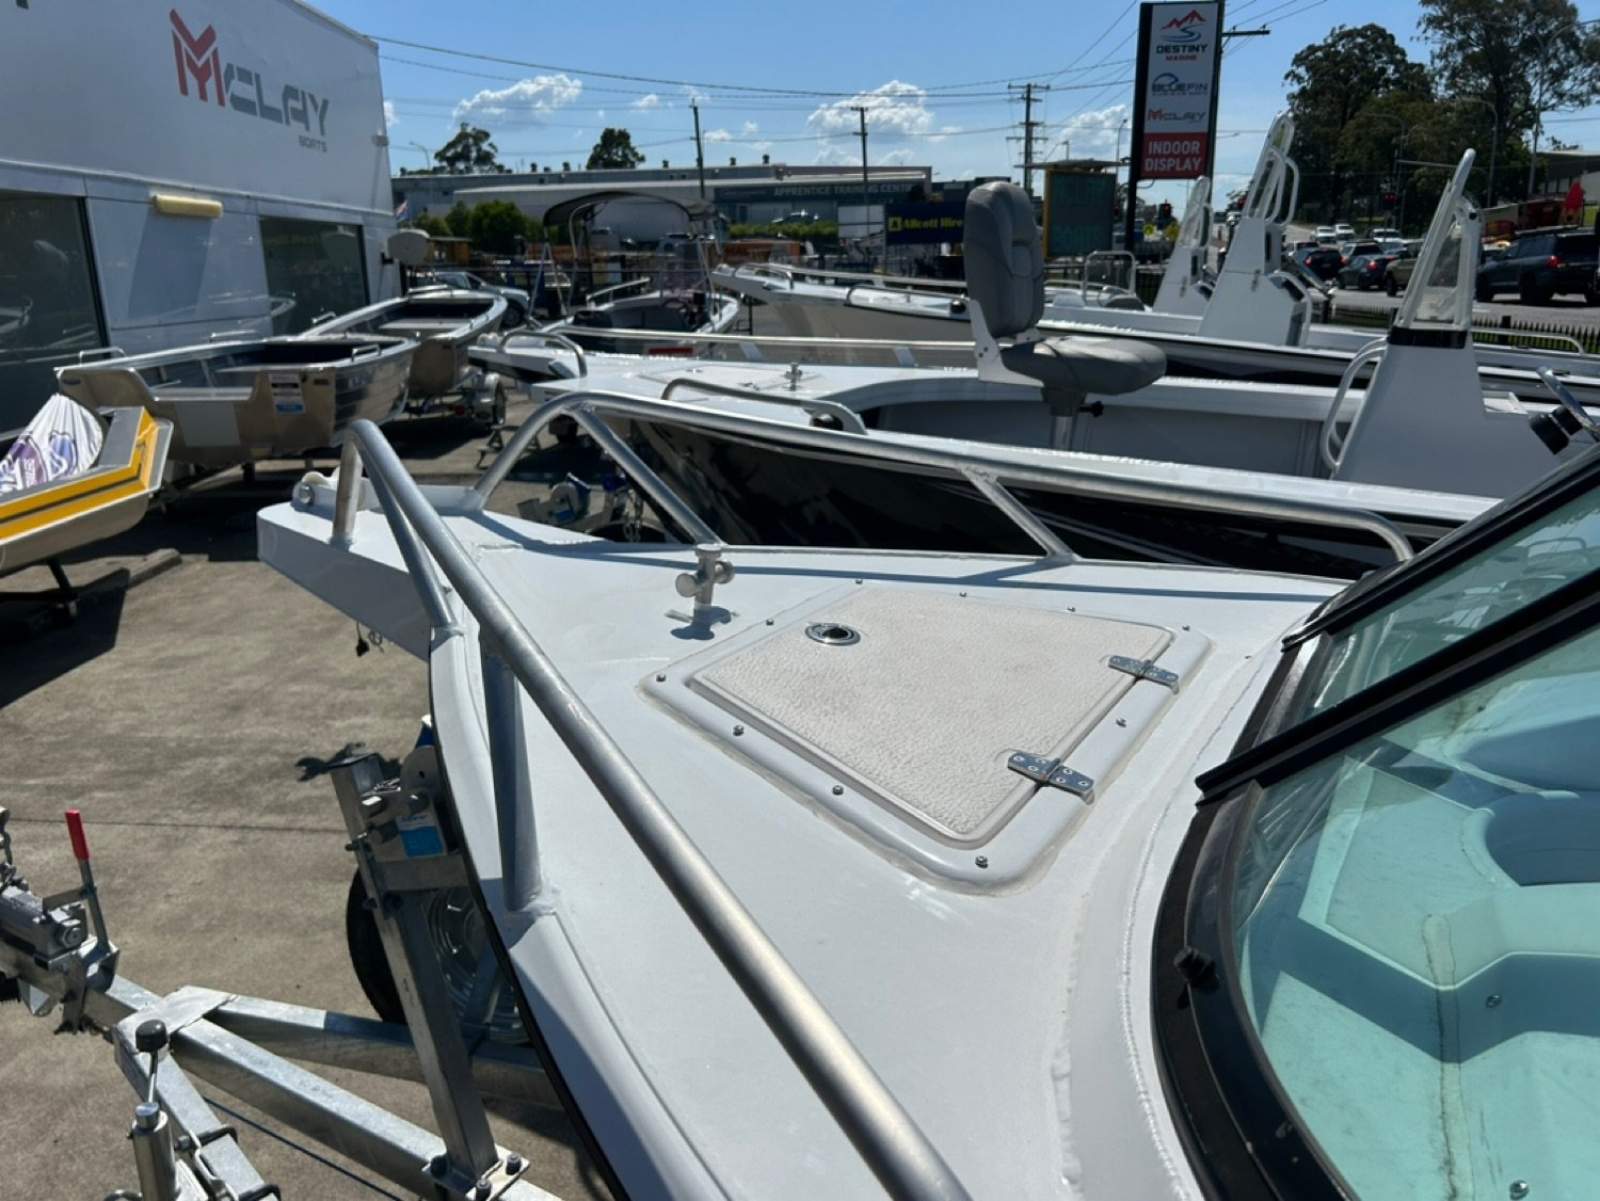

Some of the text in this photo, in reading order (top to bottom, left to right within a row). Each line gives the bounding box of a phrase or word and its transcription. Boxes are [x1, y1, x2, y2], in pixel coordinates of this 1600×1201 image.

[1157, 45, 1208, 54] DESTINY
[1149, 141, 1201, 154] INDOOR
[1145, 158, 1202, 172] DISPLAY
[774, 186, 829, 197] APPRENTICE
[880, 183, 912, 193] CENTR
